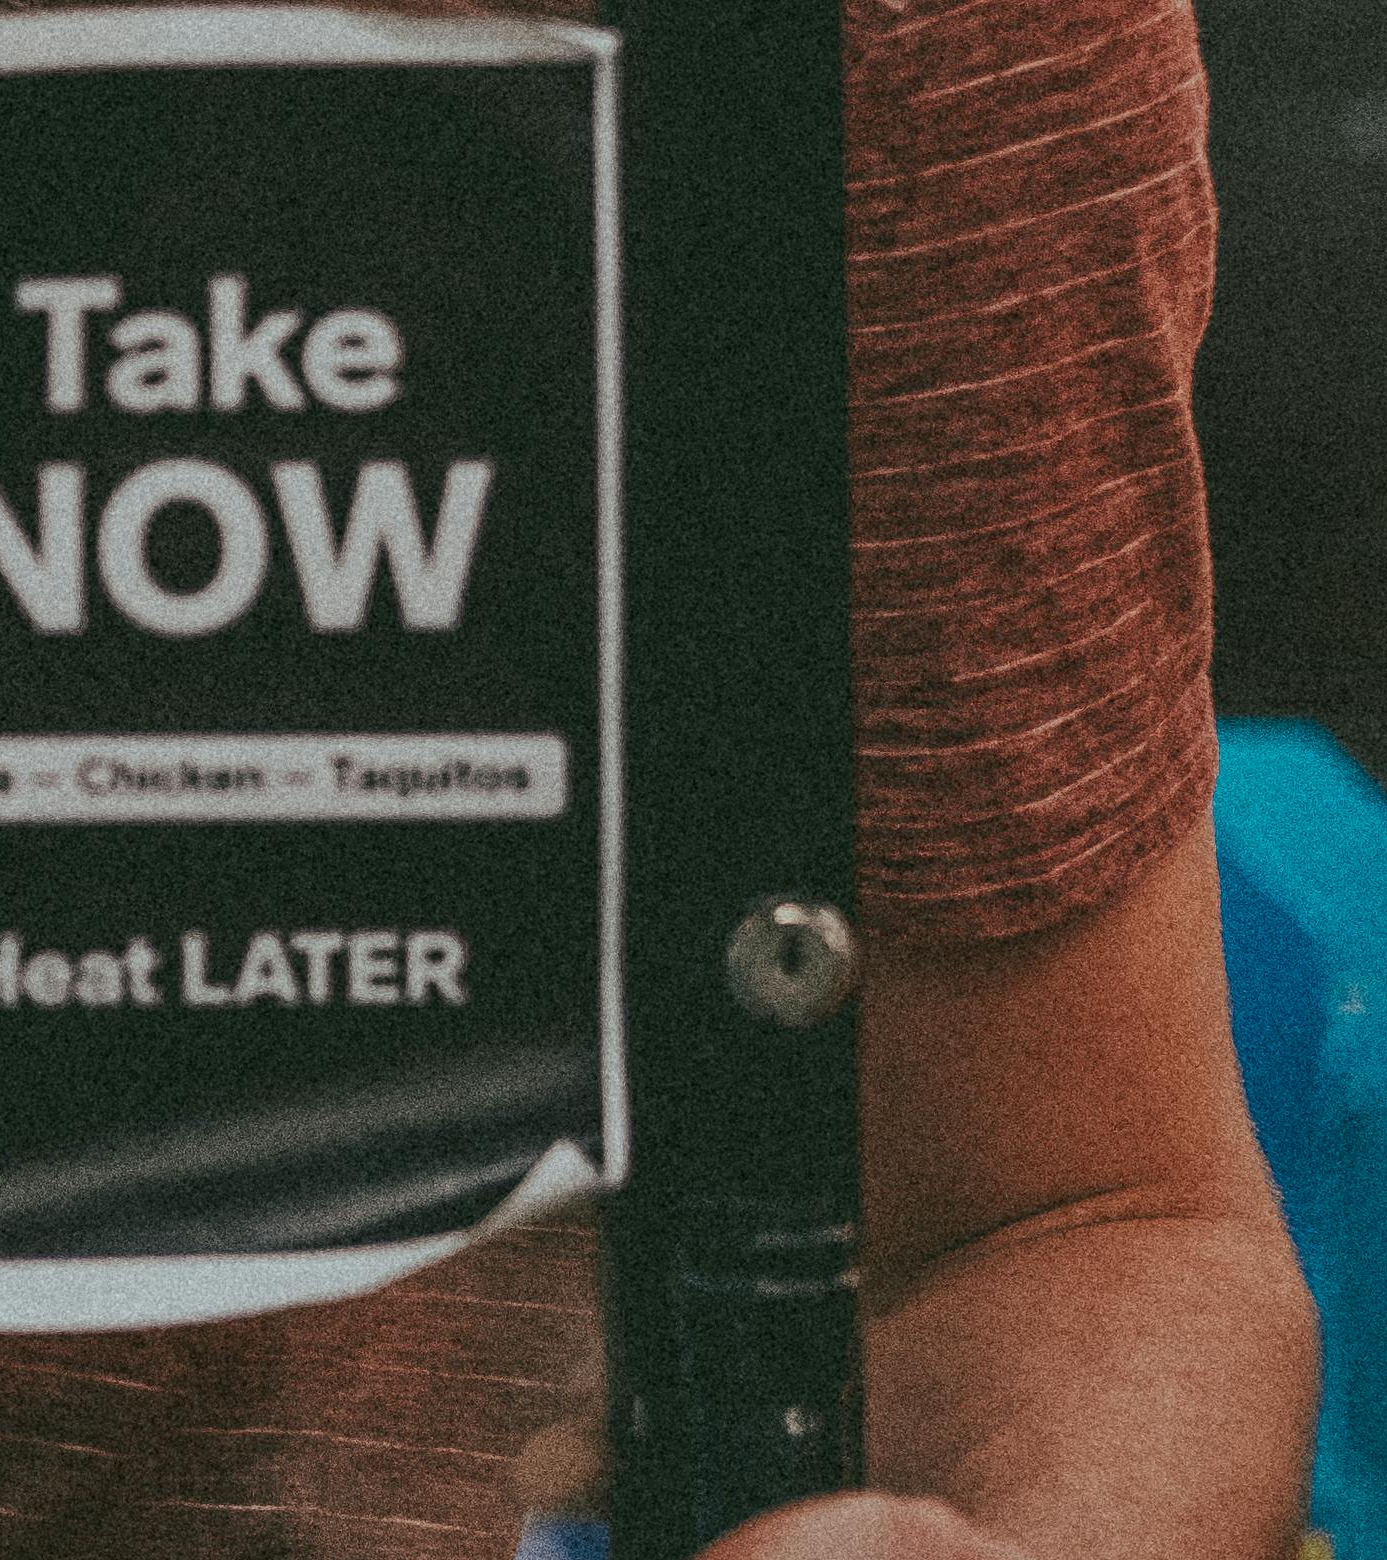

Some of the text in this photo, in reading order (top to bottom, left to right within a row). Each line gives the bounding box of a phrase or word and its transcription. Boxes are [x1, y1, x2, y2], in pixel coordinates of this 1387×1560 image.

[17, 275, 402, 411] Take
[77, 754, 266, 796] Chicken
[330, 754, 533, 808] Taquitos
[181, 930, 466, 1006] LATER
